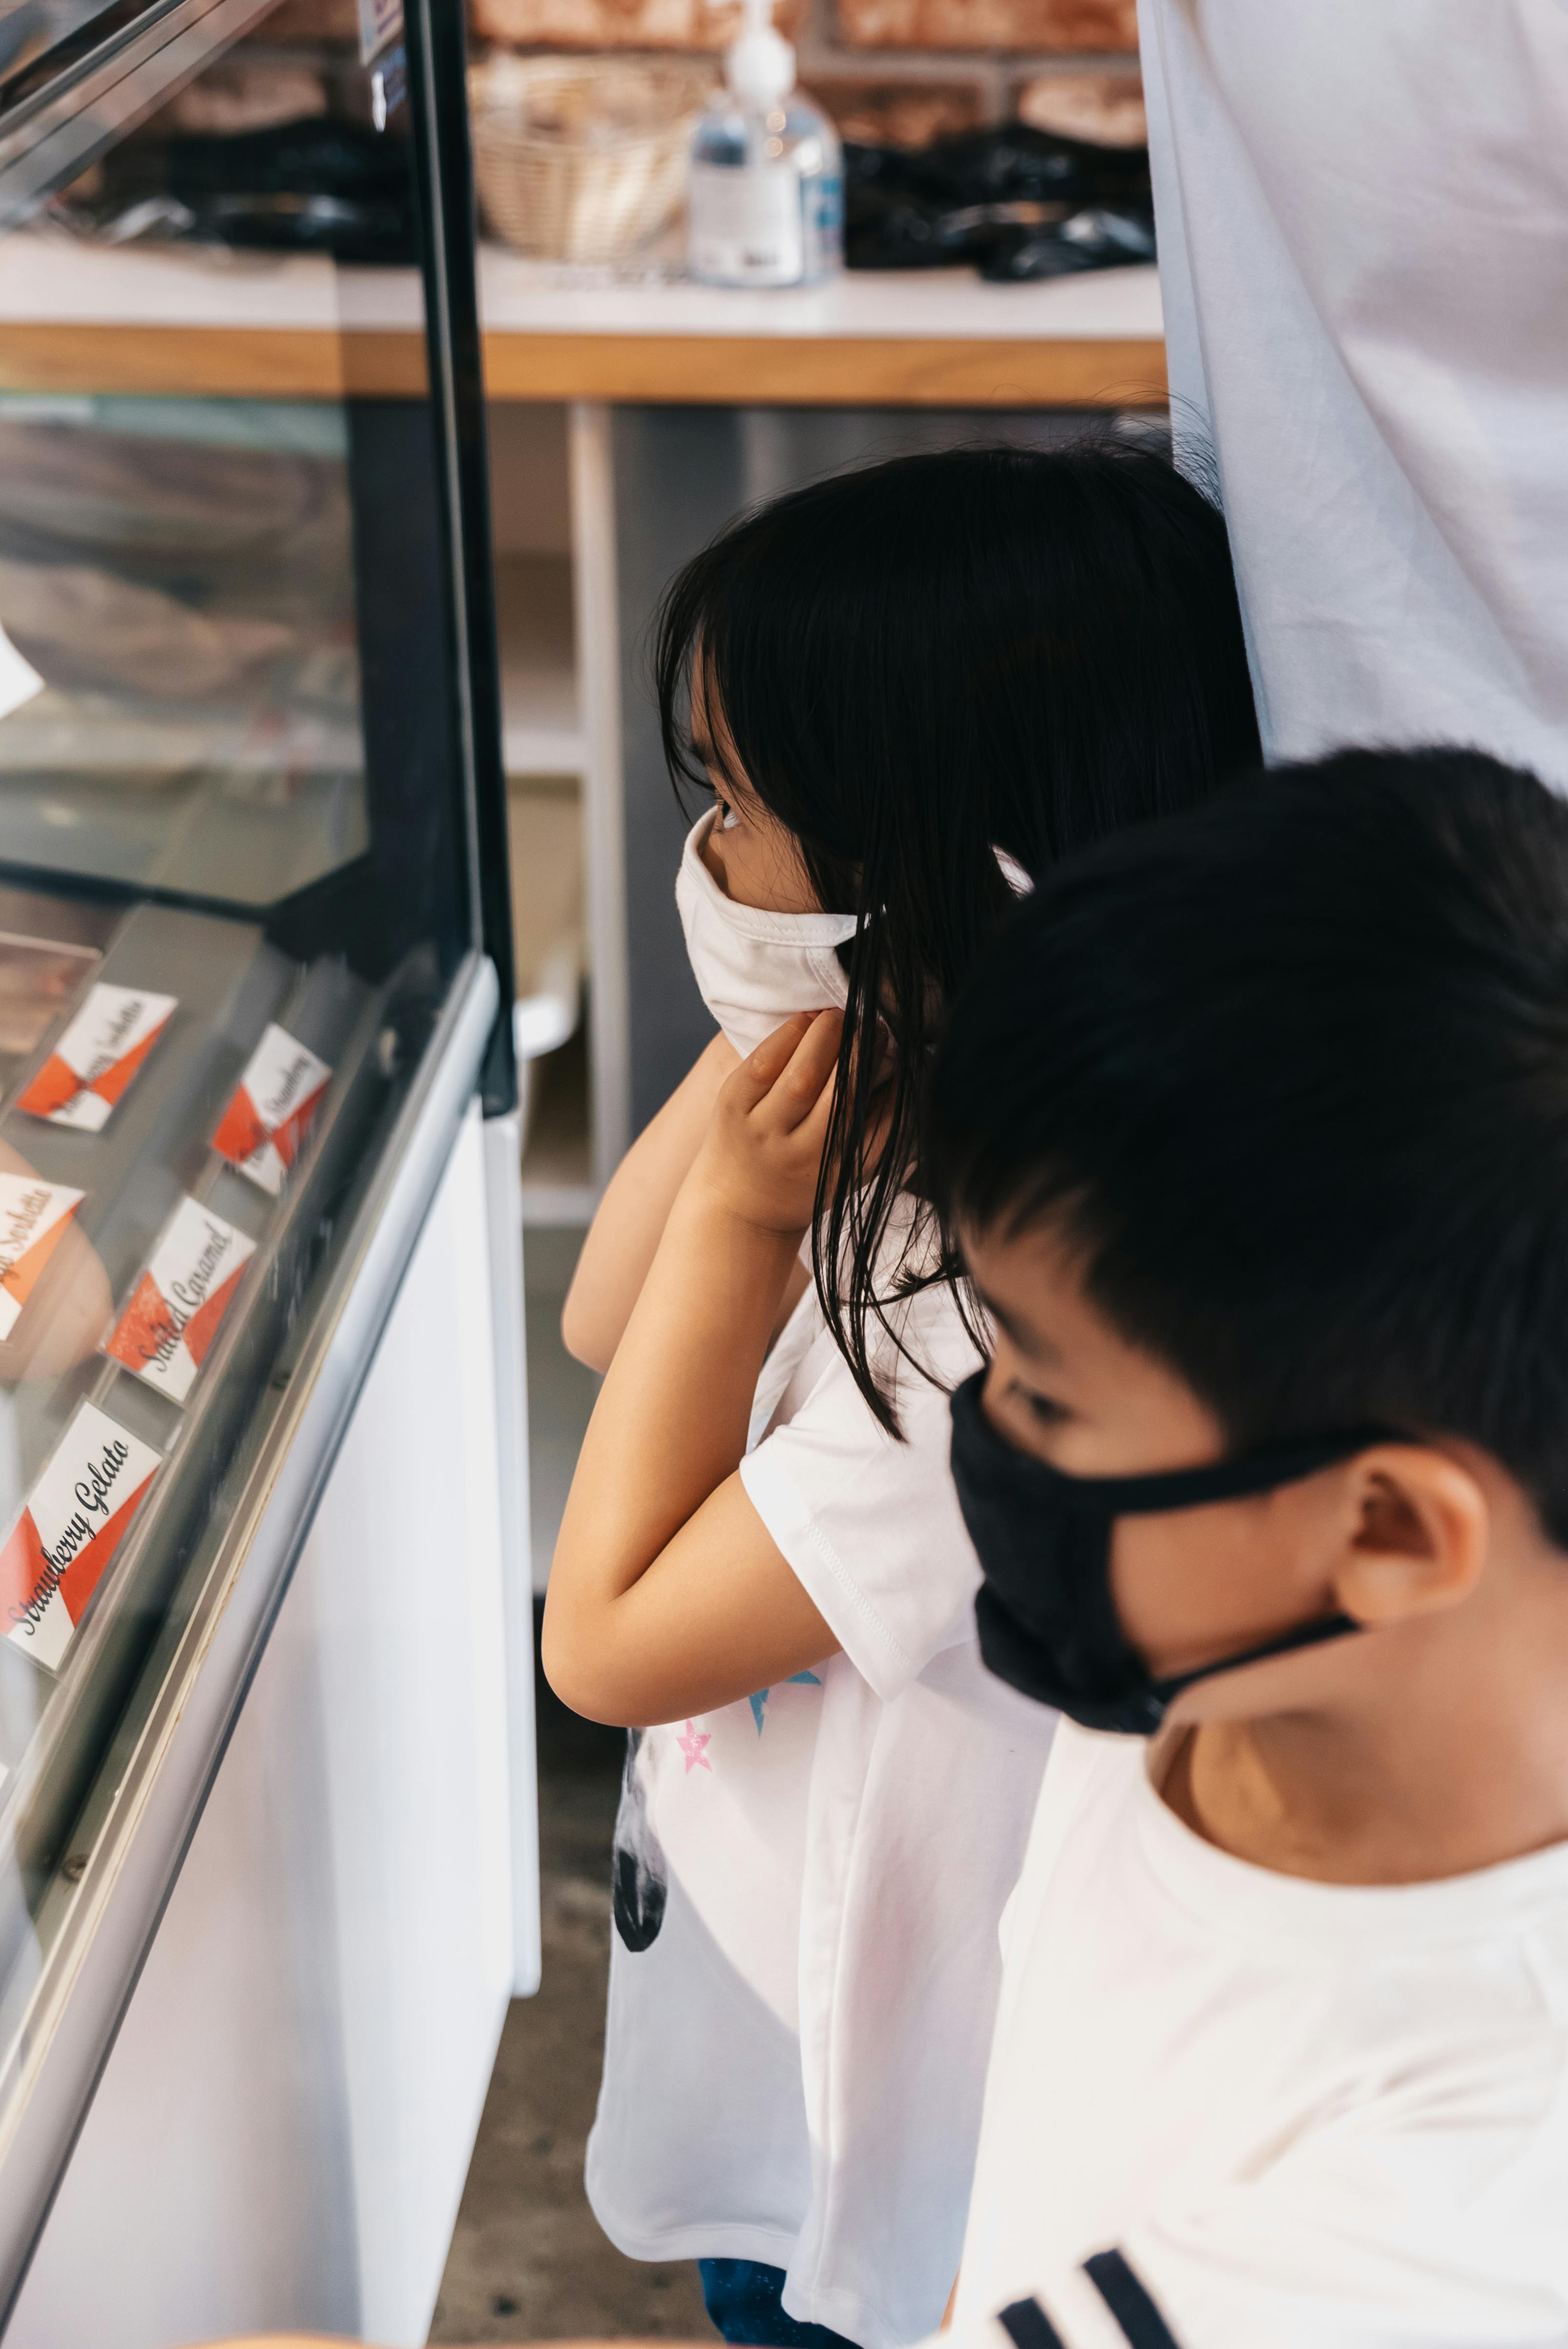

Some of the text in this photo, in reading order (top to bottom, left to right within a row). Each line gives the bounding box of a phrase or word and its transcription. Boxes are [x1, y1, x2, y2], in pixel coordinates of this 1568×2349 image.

[138, 1221, 232, 1372] Salted Caramel
[8, 1439, 129, 1636] Strawberry Gelato
